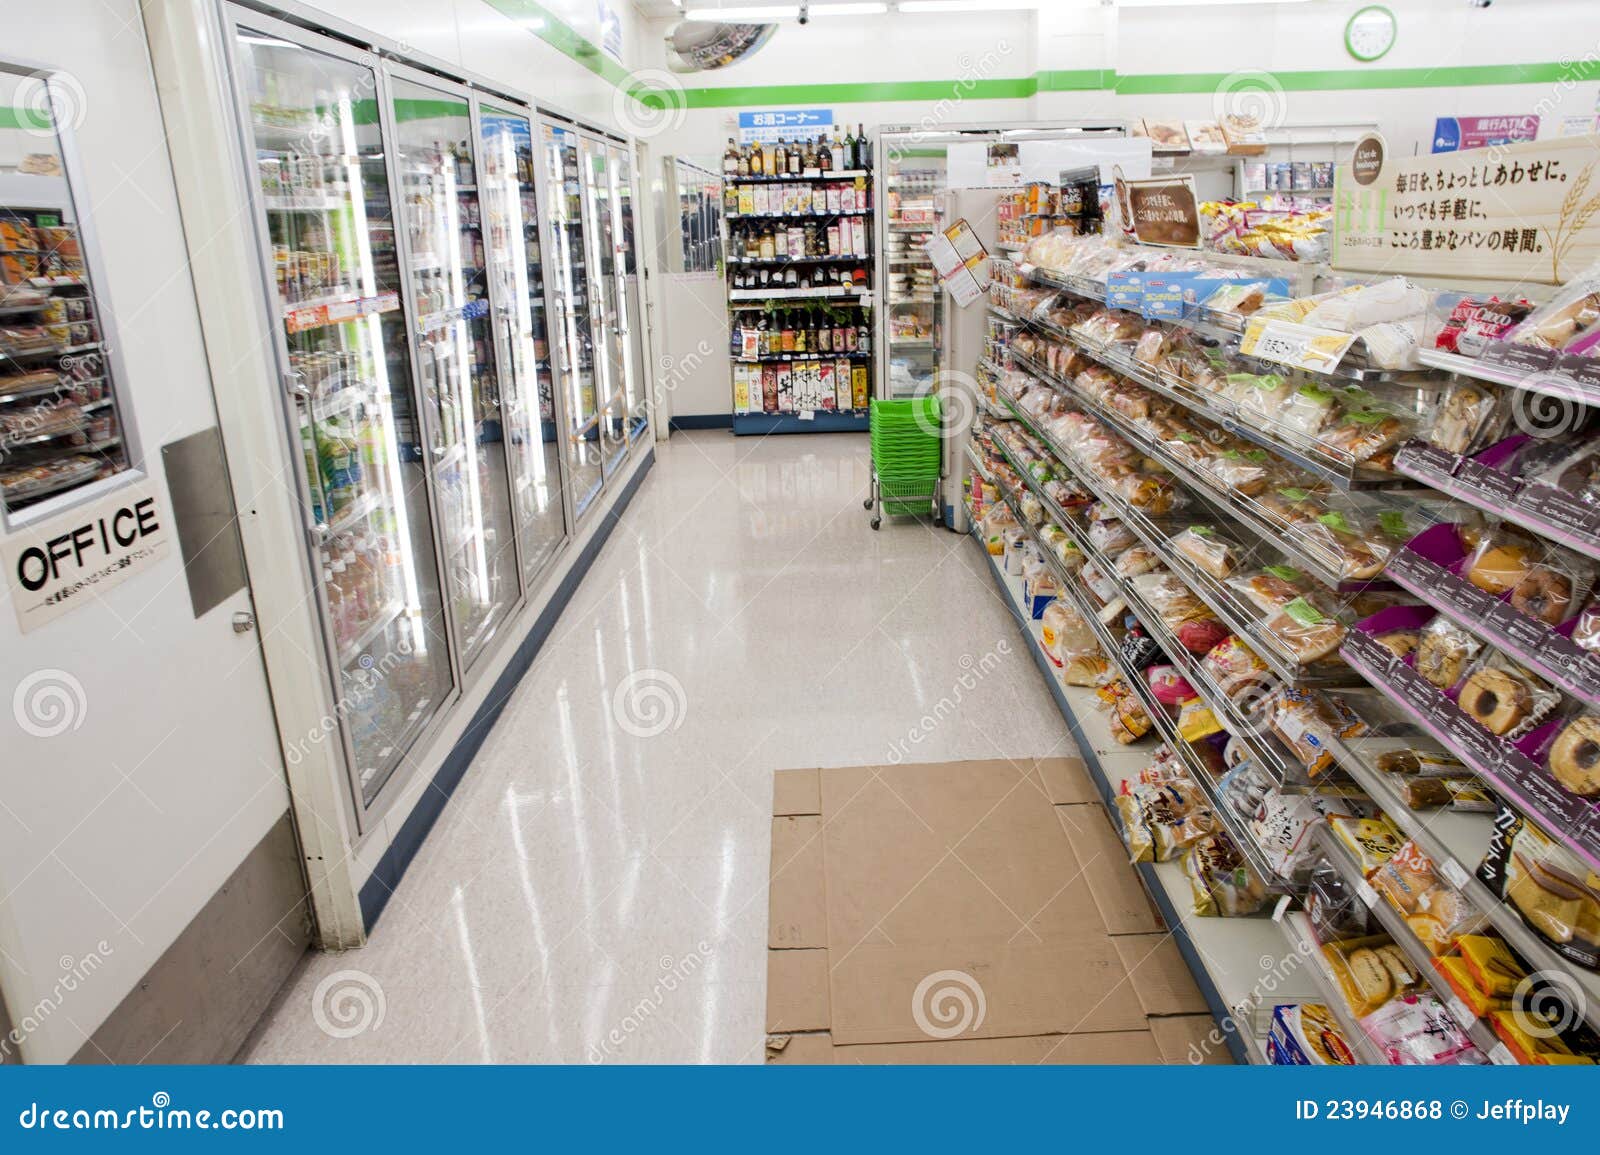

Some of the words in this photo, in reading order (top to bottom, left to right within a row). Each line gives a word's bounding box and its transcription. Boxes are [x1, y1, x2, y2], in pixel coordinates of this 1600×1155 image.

[1396, 160, 1568, 194] 毎日を、ちょっとしあわせに。
[1393, 199, 1488, 221] いつでも手軽に、
[1391, 228, 1543, 253] こころ豊かなパンの時間。
[18, 497, 160, 591] OFFICE
